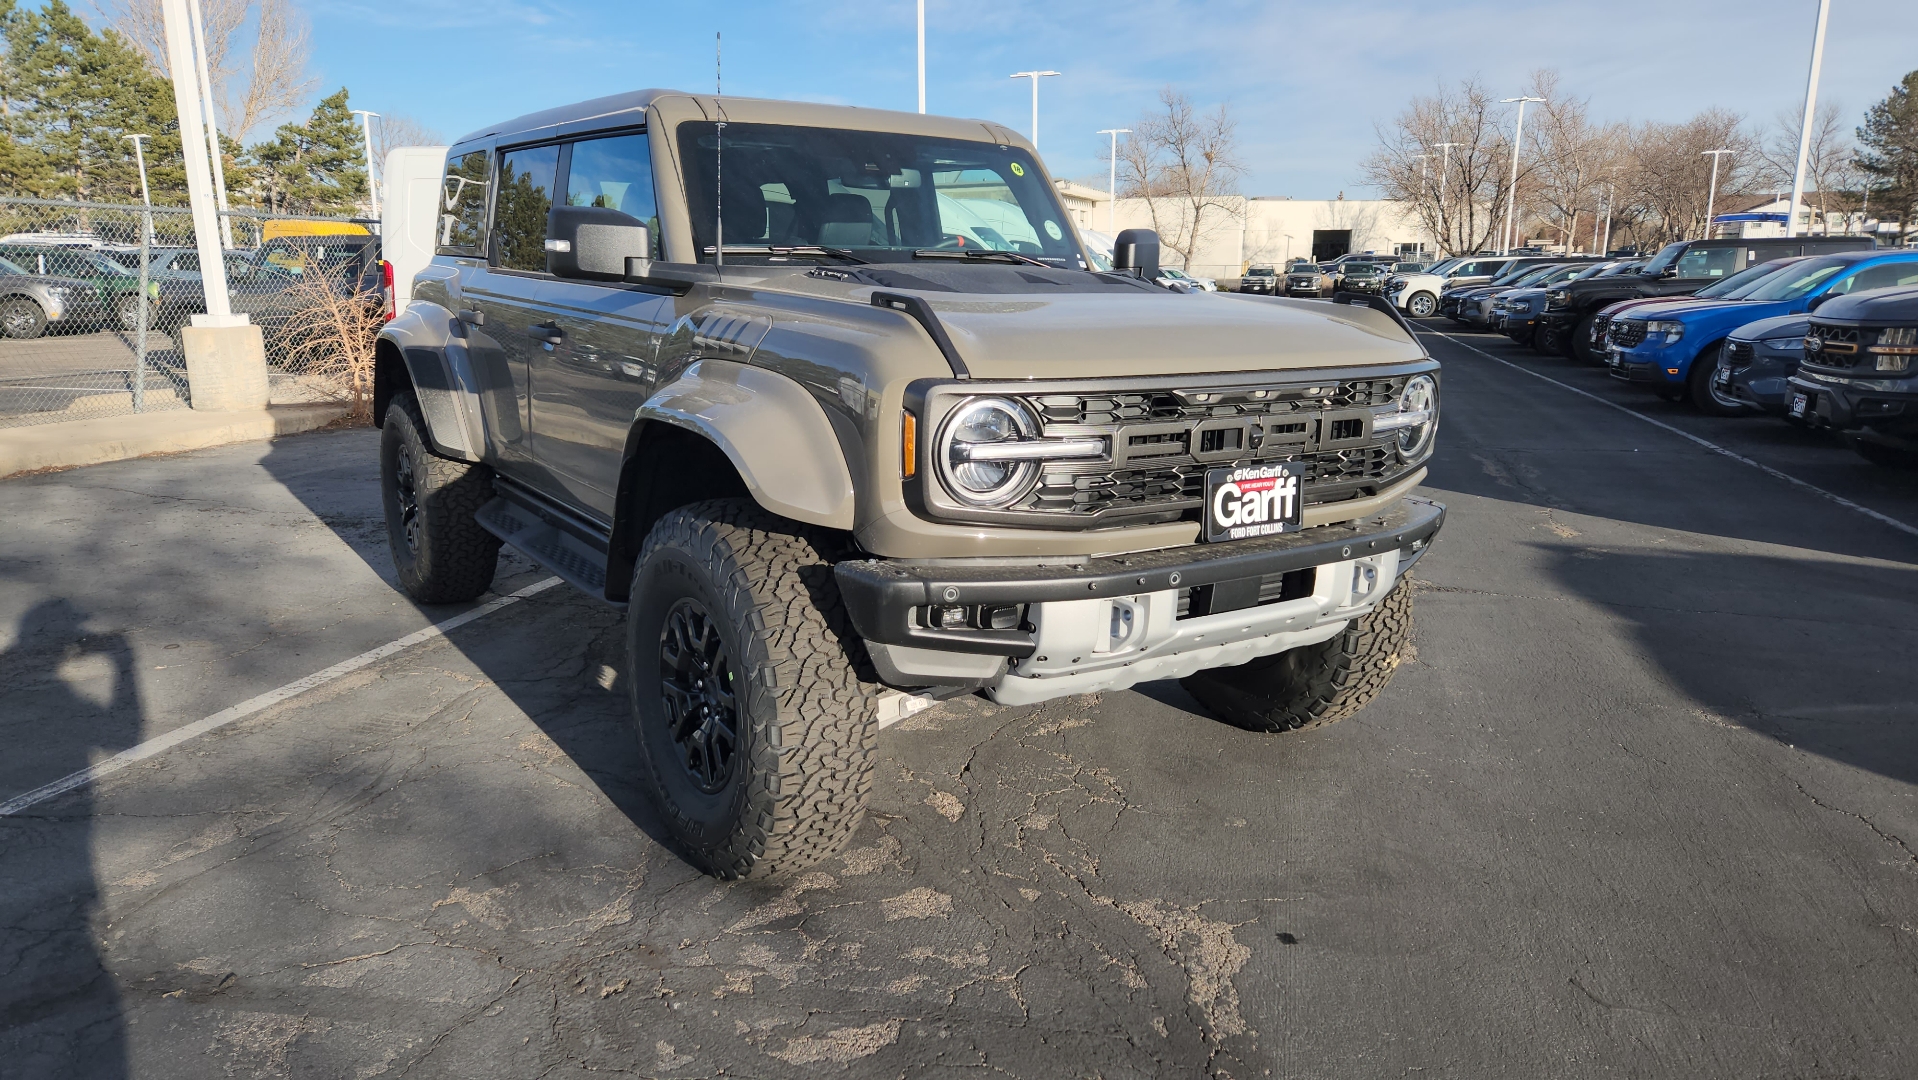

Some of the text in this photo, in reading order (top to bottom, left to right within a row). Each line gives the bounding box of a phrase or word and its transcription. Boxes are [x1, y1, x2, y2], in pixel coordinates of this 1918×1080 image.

[1111, 410, 1374, 470] FORD
[1242, 466, 1282, 480] Ken Garff
[1214, 476, 1296, 527] Garff
[1230, 522, 1283, 539] FORD FORT COLLINS
